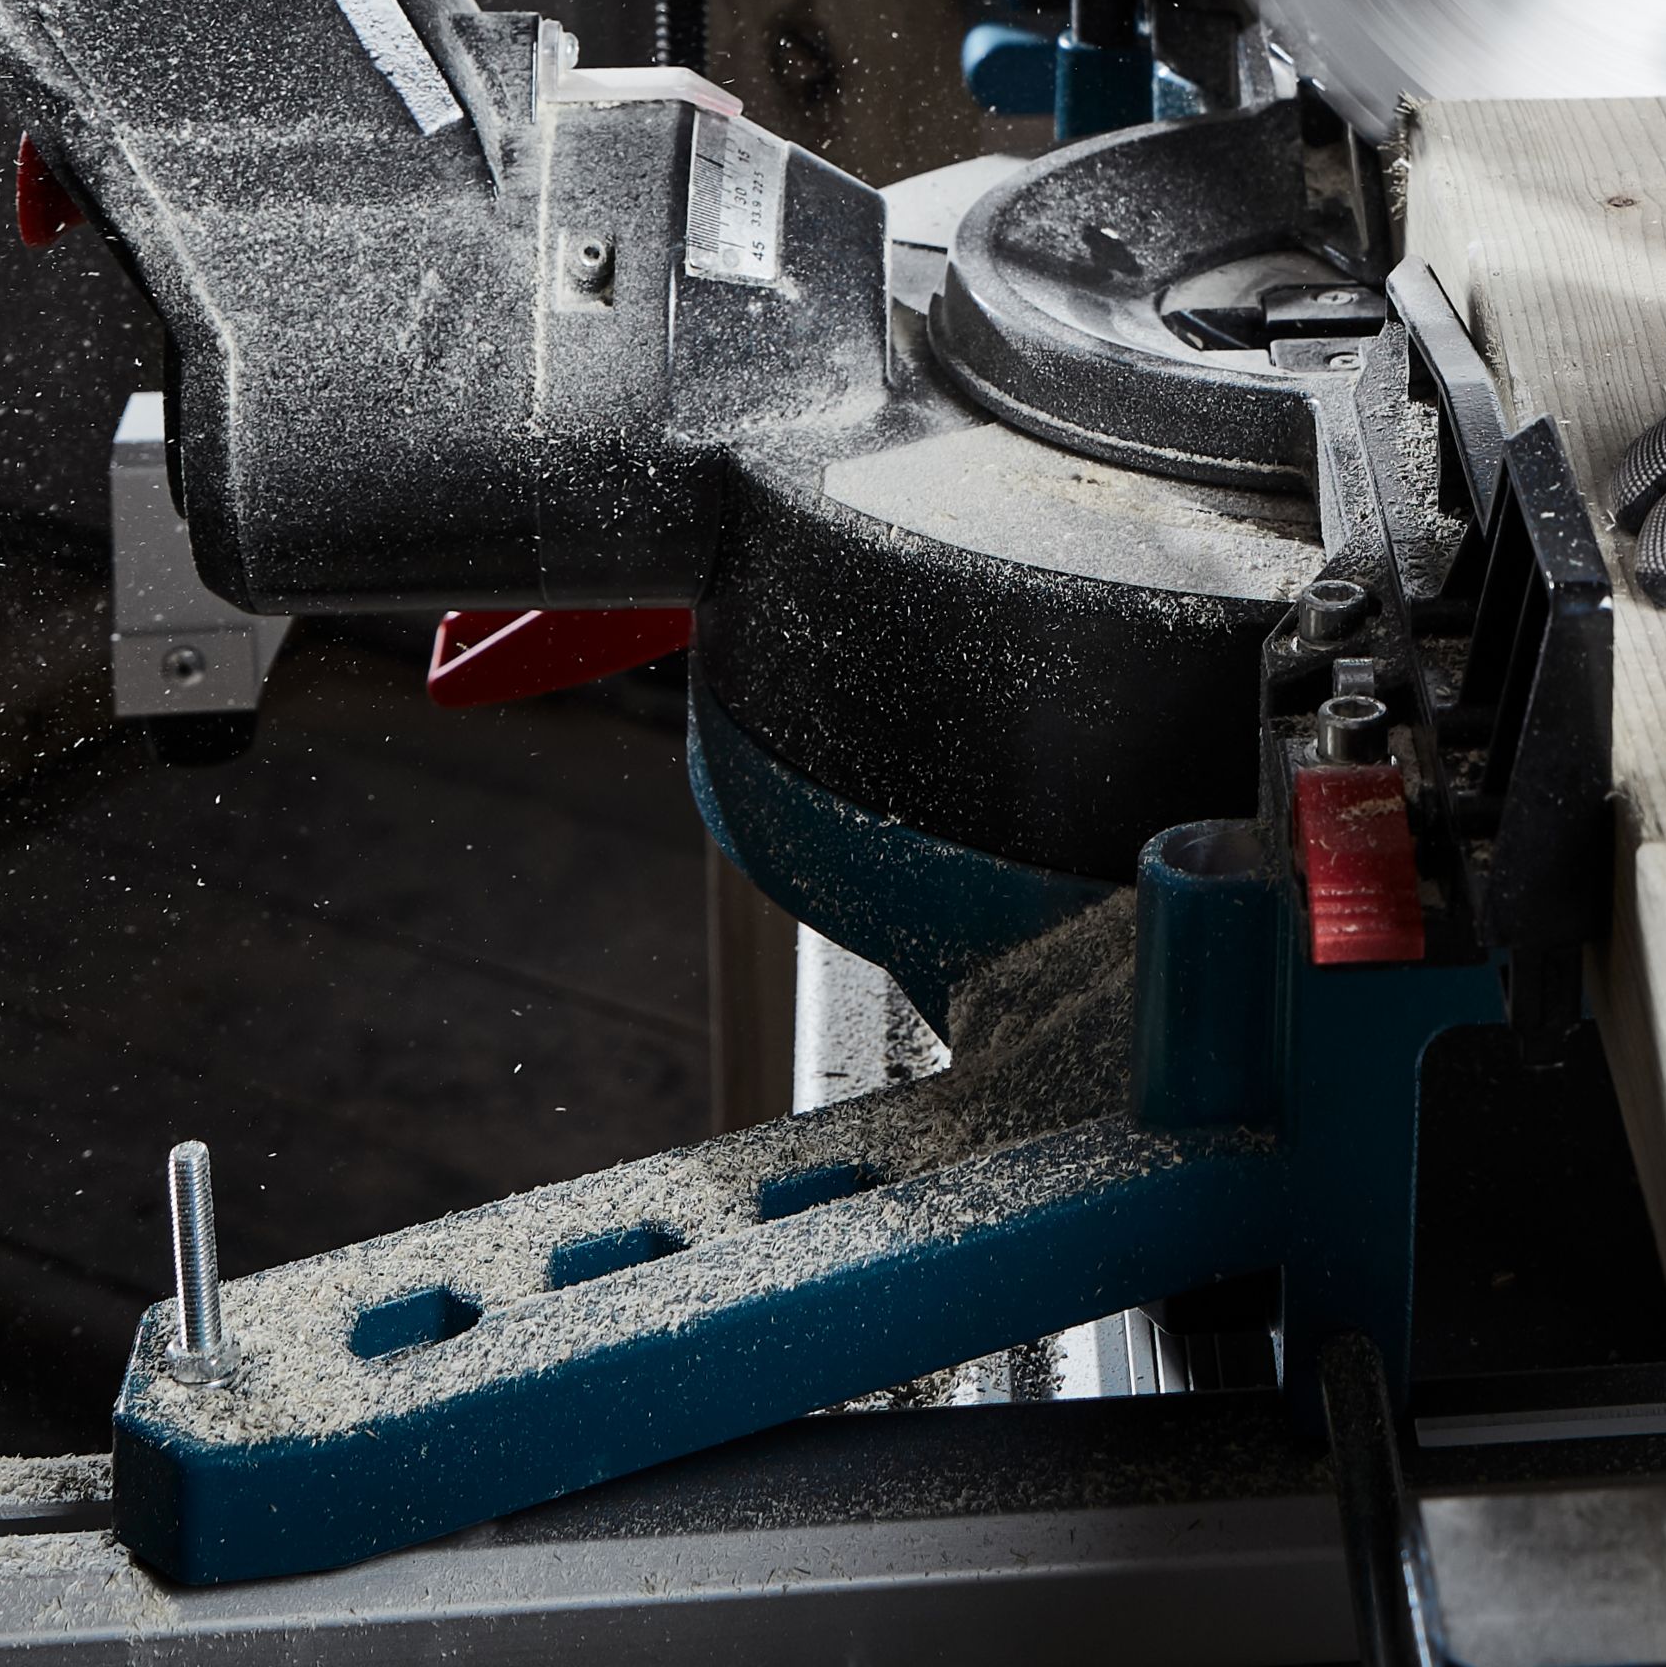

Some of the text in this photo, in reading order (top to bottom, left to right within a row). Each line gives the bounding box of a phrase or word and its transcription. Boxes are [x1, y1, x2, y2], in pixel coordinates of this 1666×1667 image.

[734, 149, 750, 206] 30 15
[751, 200, 763, 227] 33.9
[752, 241, 765, 261] 45
